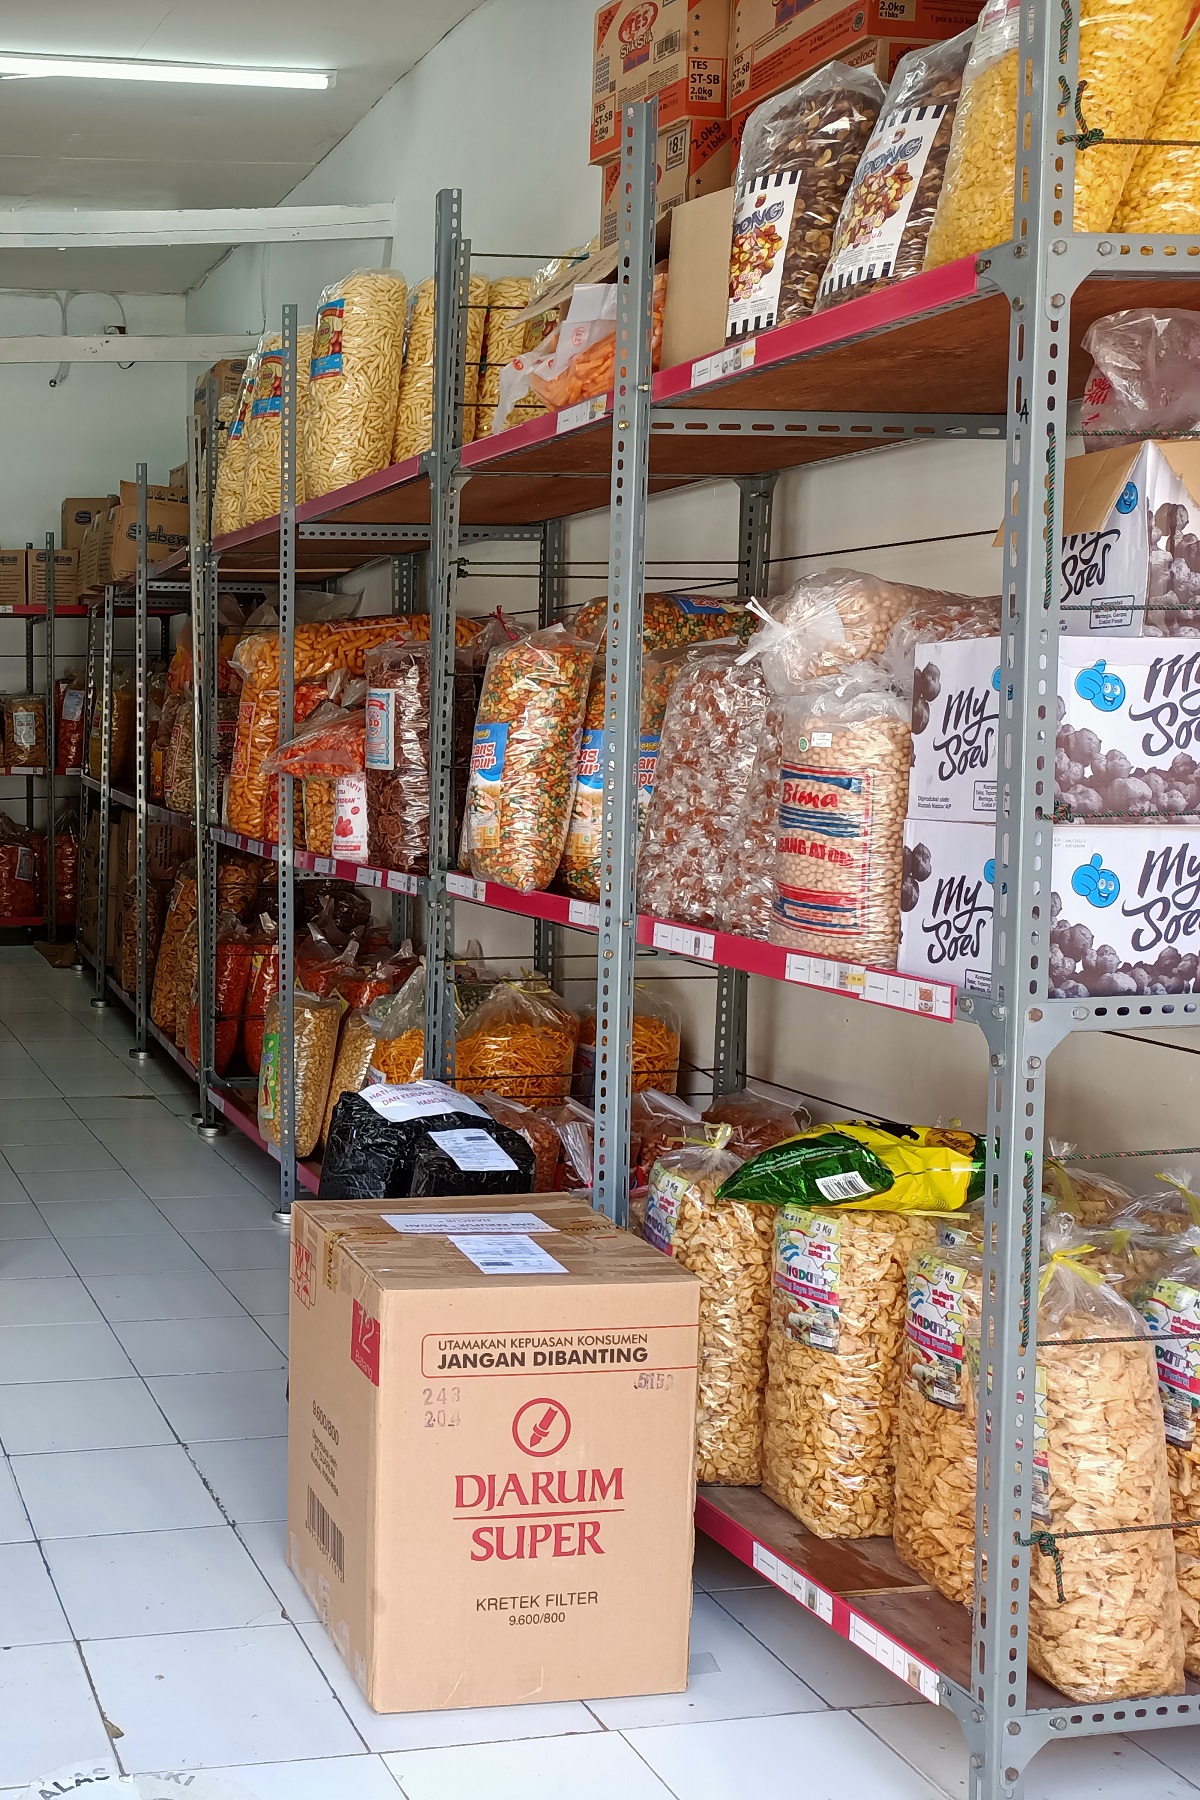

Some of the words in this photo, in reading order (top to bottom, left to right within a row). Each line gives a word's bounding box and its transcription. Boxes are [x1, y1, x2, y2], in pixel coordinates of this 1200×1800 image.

[691, 60, 708, 70] TES
[734, 53, 744, 67] TES
[690, 74, 720, 85] ST-SB
[732, 62, 750, 82] ST-SB
[690, 86, 713, 97] 2.0kg
[595, 102, 606, 114] TES
[692, 121, 721, 149] 2.0kg
[707, 132, 727, 151] 1bks
[1060, 543, 1111, 604] Soes
[941, 687, 1000, 740] My
[933, 727, 995, 782] Soes
[782, 781, 839, 809] Bima
[932, 875, 994, 934] My
[1122, 896, 1200, 952] Soe
[921, 916, 987, 964] Soes
[382, 1096, 400, 1106] DAN
[815, 1223, 821, 1232] 3
[821, 1224, 832, 1236] Kg
[945, 1232, 955, 1245] Kg
[944, 1271, 955, 1285] Kg
[438, 1339, 507, 1351] UTAMAKAN
[510, 1336, 574, 1349] KEPUASAN
[577, 1333, 648, 1347] KONSUMEN
[355, 1350, 373, 1381] Batang
[437, 1352, 526, 1370] JANGAN
[533, 1347, 648, 1367] DIBANTING
[312, 1400, 340, 1447] 9.600/800
[454, 1467, 625, 1512] DJARUM
[470, 1521, 606, 1562] SUPER
[476, 1595, 541, 1612] KRETEK
[545, 1591, 599, 1607] FILTER
[508, 1612, 566, 1626] 9.600/800
